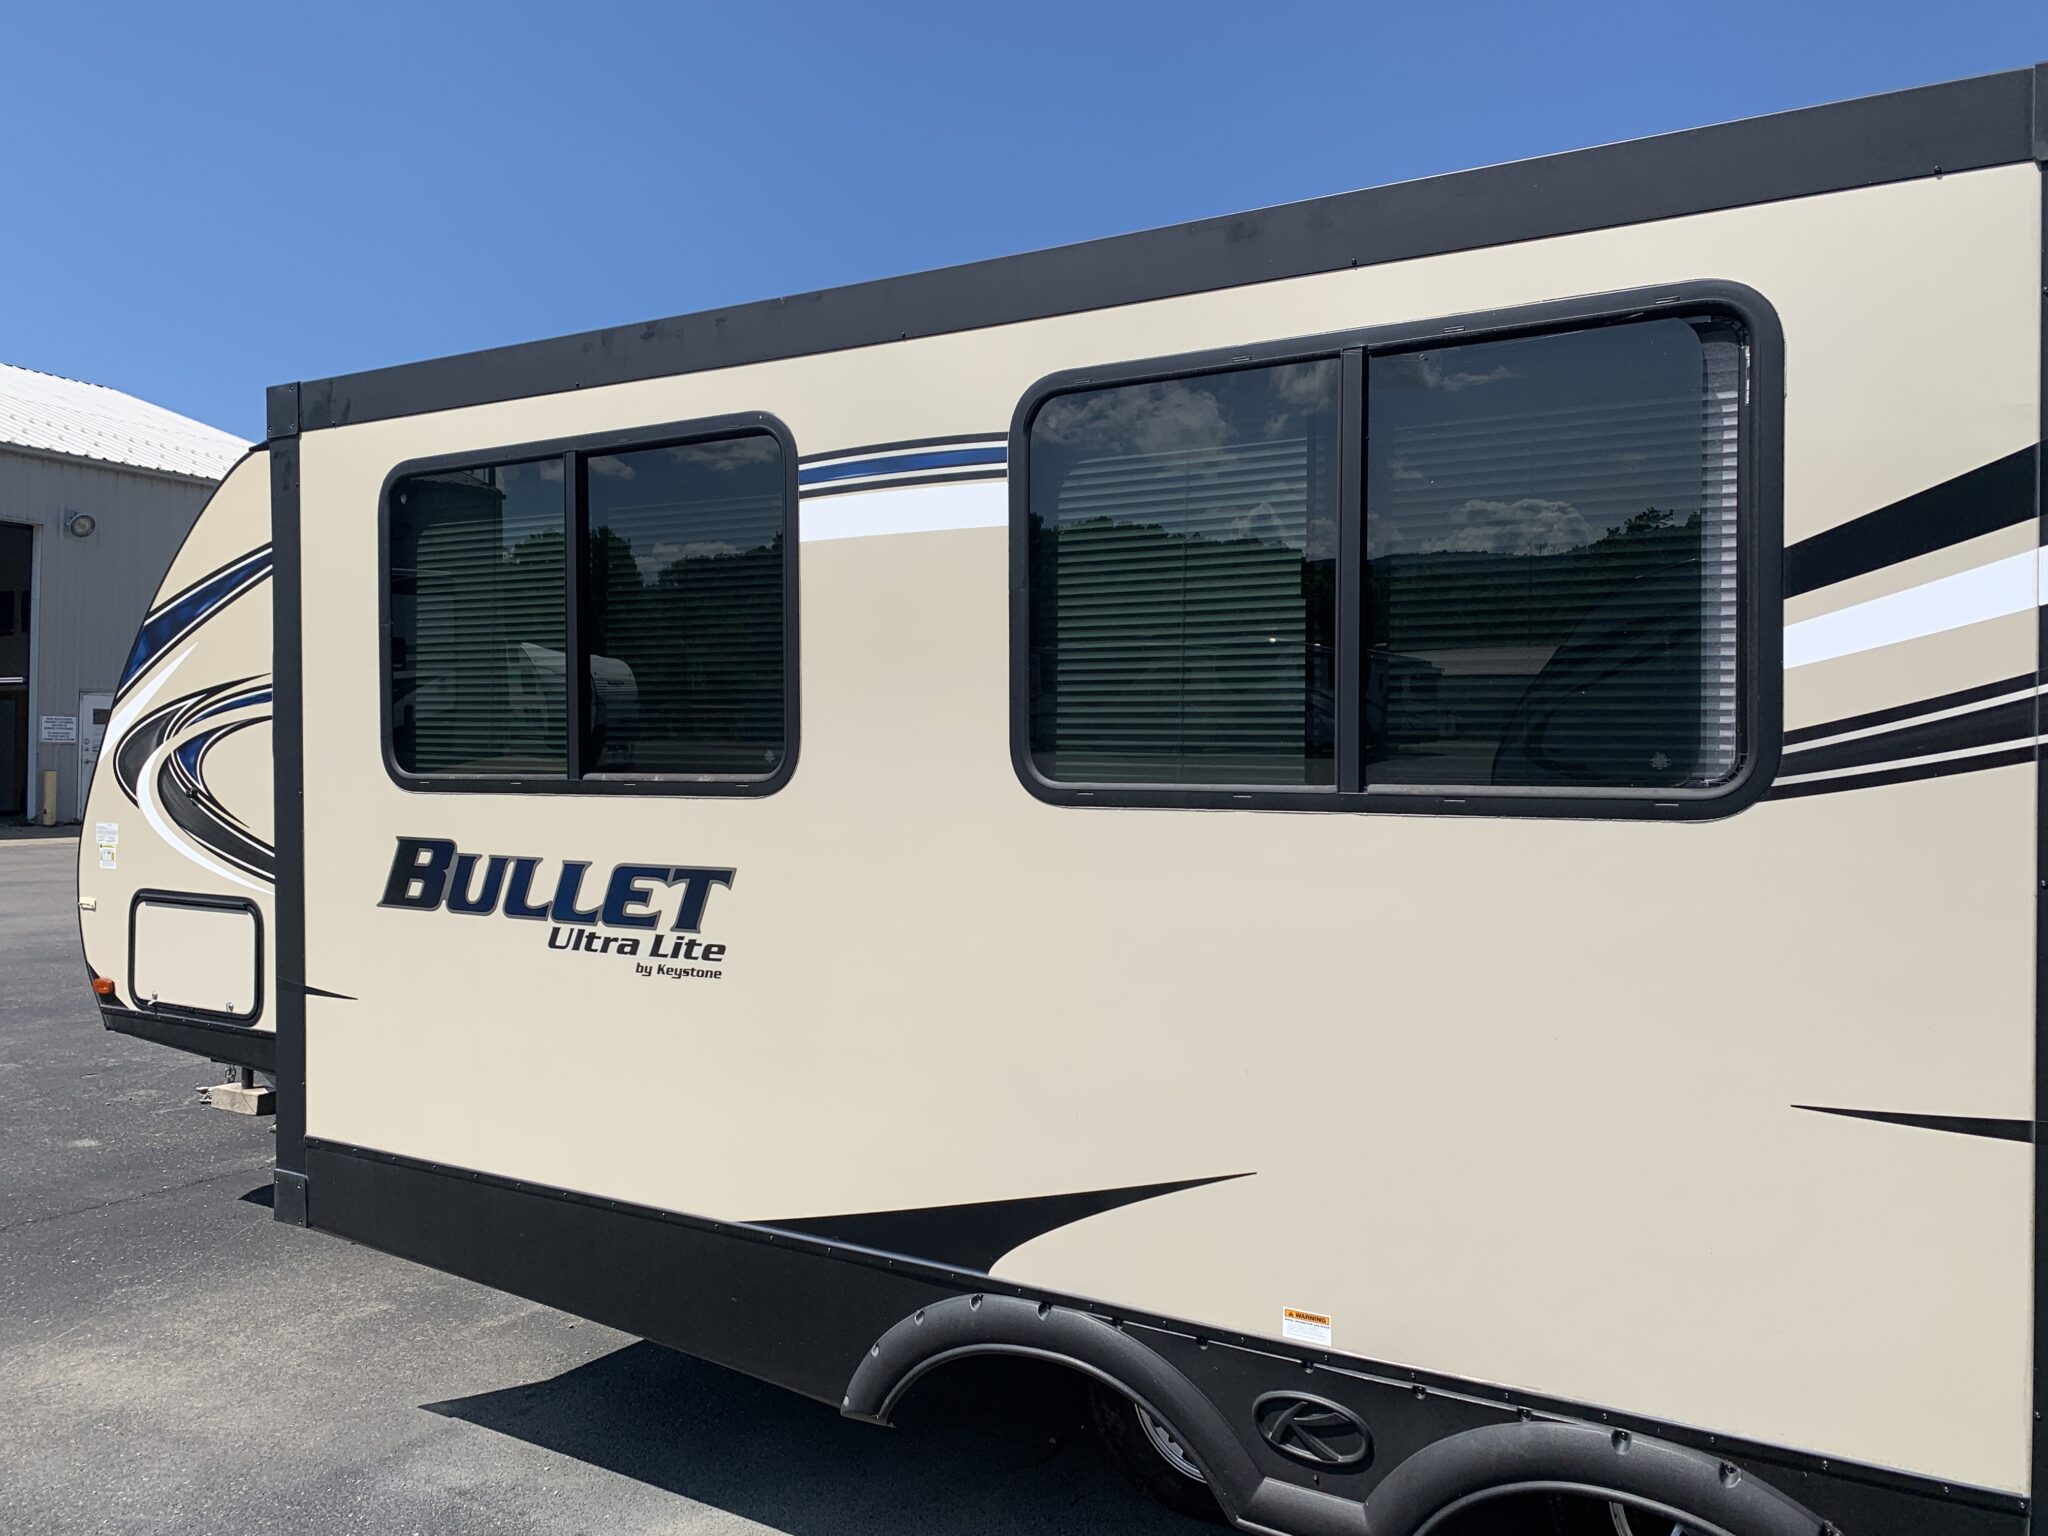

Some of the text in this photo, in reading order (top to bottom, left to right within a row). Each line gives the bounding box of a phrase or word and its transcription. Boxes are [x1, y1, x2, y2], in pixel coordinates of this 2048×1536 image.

[376, 836, 737, 934] BULLET
[547, 926, 727, 962] Ultra Lite
[635, 962, 723, 980] by Keystone
[1295, 1311, 1327, 1324] WARNING
